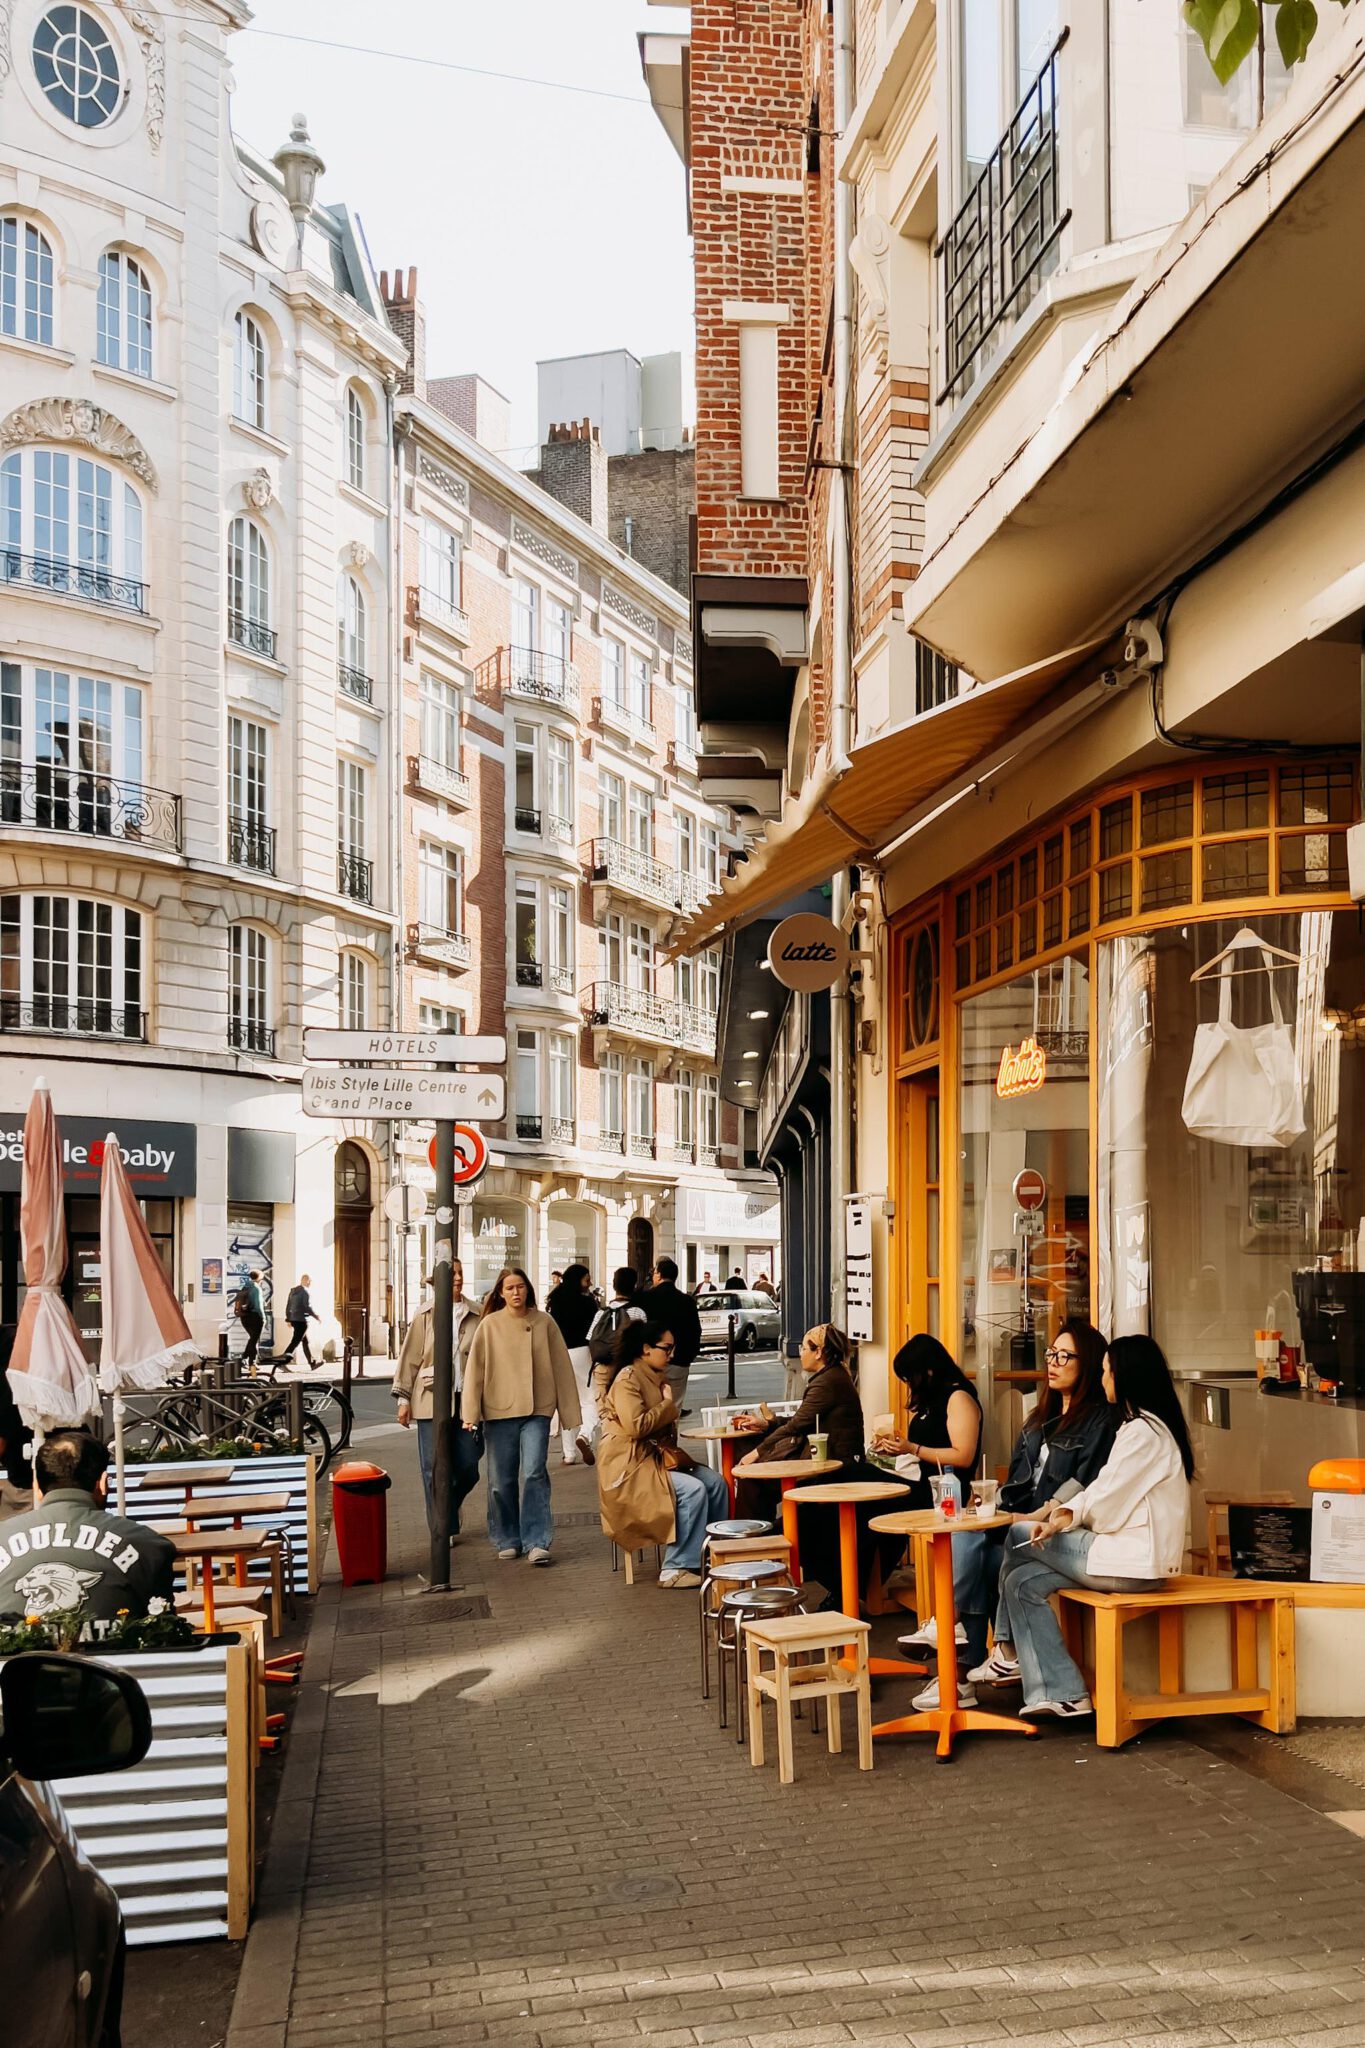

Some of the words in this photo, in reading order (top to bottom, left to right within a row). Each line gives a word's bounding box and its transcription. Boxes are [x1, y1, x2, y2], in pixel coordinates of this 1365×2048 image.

[781, 941, 836, 961] latte
[368, 1036, 438, 1054] HÔTELS
[310, 1077, 336, 1090] Ibis
[341, 1077, 379, 1094] Style
[383, 1078, 413, 1092] Lille
[418, 1080, 467, 1094] Centre
[311, 1095, 361, 1109] Grand
[368, 1096, 413, 1111] Place
